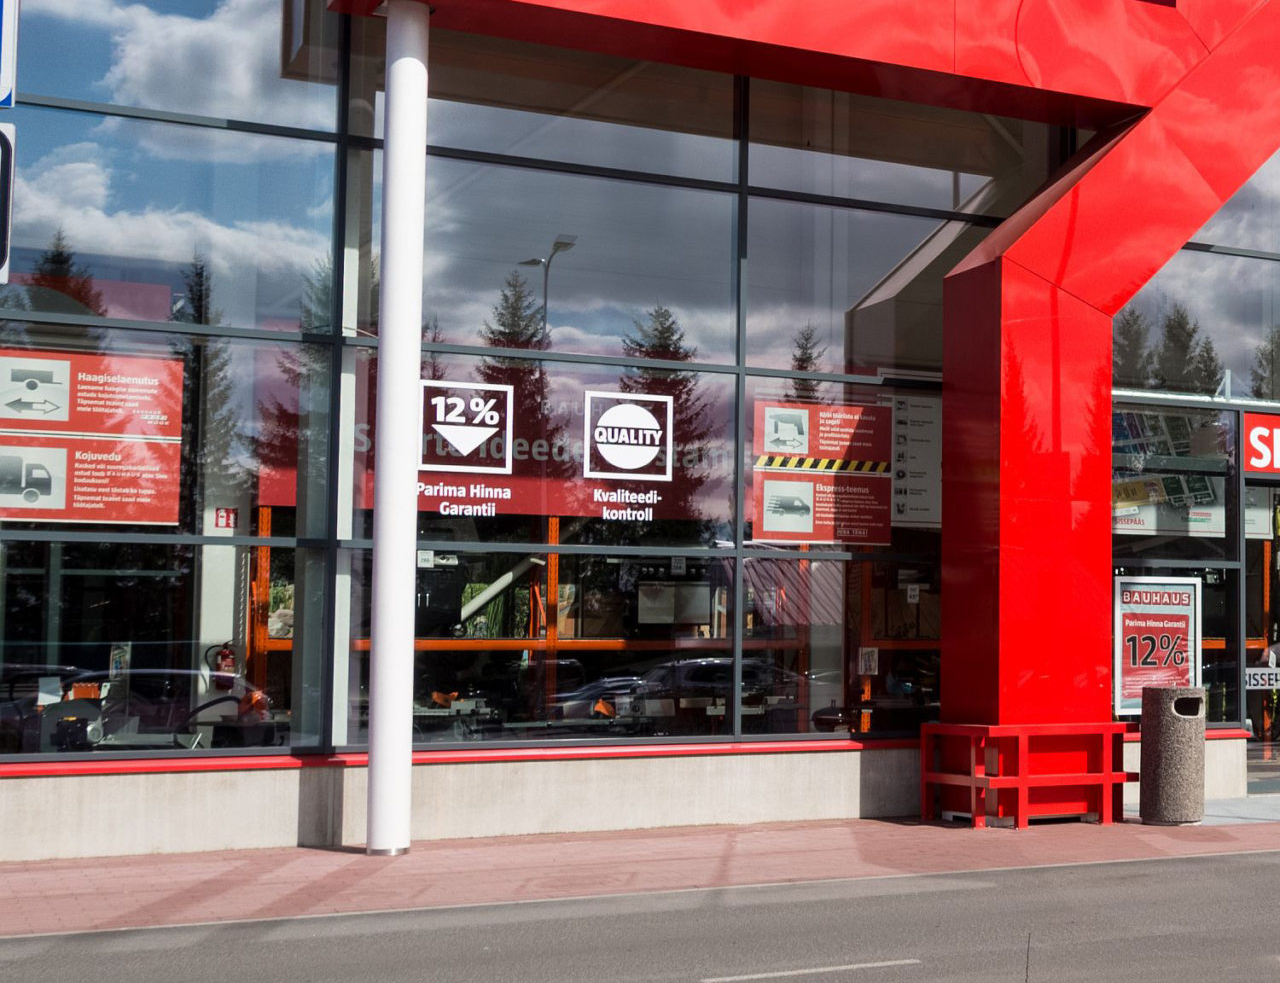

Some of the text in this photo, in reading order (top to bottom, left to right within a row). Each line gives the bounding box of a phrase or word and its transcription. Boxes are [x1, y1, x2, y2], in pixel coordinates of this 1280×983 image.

[78, 372, 159, 386] Haagiselaenutus
[431, 396, 500, 425] 12%
[594, 426, 664, 446] QUALITY
[75, 451, 121, 461] Kojuvedu
[417, 481, 511, 499] Parima Hinna
[593, 489, 663, 504] Kvaliteedi-
[440, 502, 496, 516] Garantii
[602, 506, 653, 521] kontroll
[1123, 592, 1189, 604] BAUHAUS
[1125, 619, 1146, 627] Parima
[1126, 633, 1185, 667] 12%
